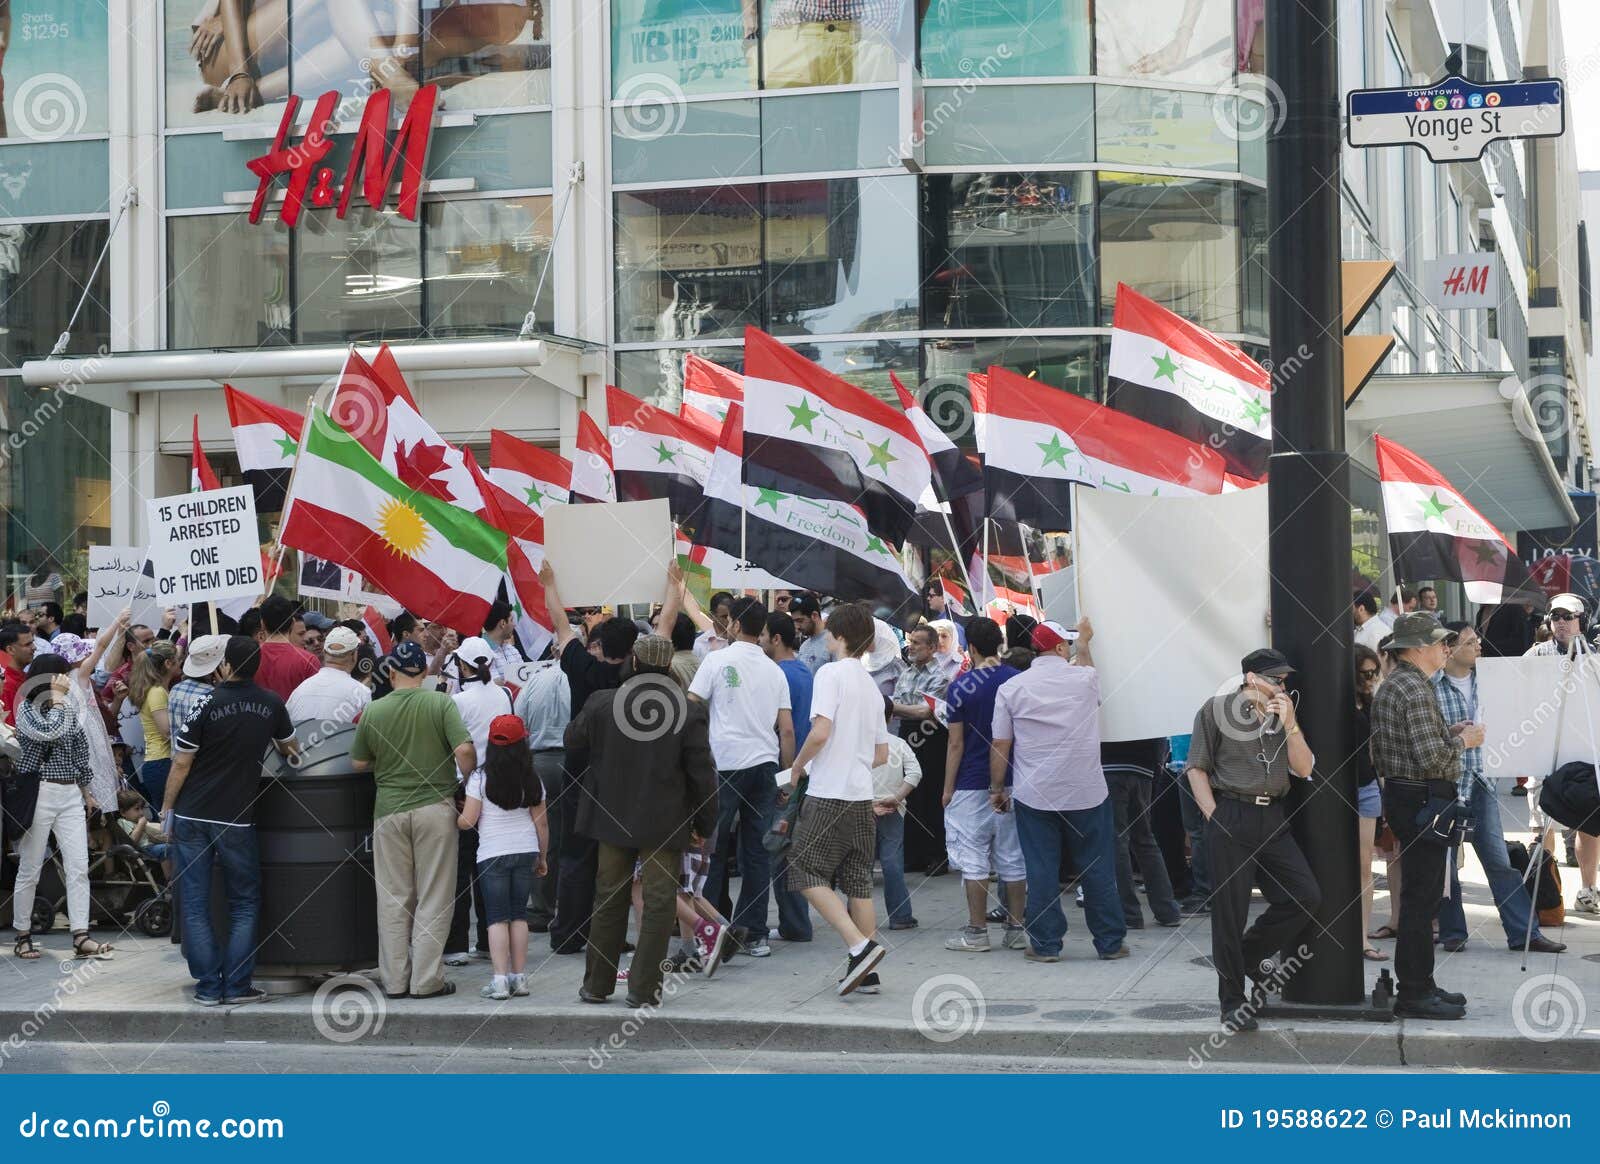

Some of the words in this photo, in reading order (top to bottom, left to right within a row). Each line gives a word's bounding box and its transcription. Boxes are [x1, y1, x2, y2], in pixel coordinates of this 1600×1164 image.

[22, 13, 54, 23] Shorts
[1407, 88, 1460, 97] DOWNTOWN
[1405, 115, 1473, 141] Yonge
[1481, 111, 1502, 133] St
[246, 83, 438, 227] H&M
[1443, 265, 1490, 296] H&M
[158, 506, 172, 522] 15
[178, 495, 247, 519] CHILDREN
[169, 518, 241, 542] ARRESTED
[786, 510, 857, 551] Freedom
[190, 546, 219, 567] ONE
[159, 577, 176, 595] OF
[181, 570, 220, 592] THEM
[226, 566, 258, 586] DIED
[210, 701, 237, 721] OAKS
[239, 701, 272, 719] VALLEY
